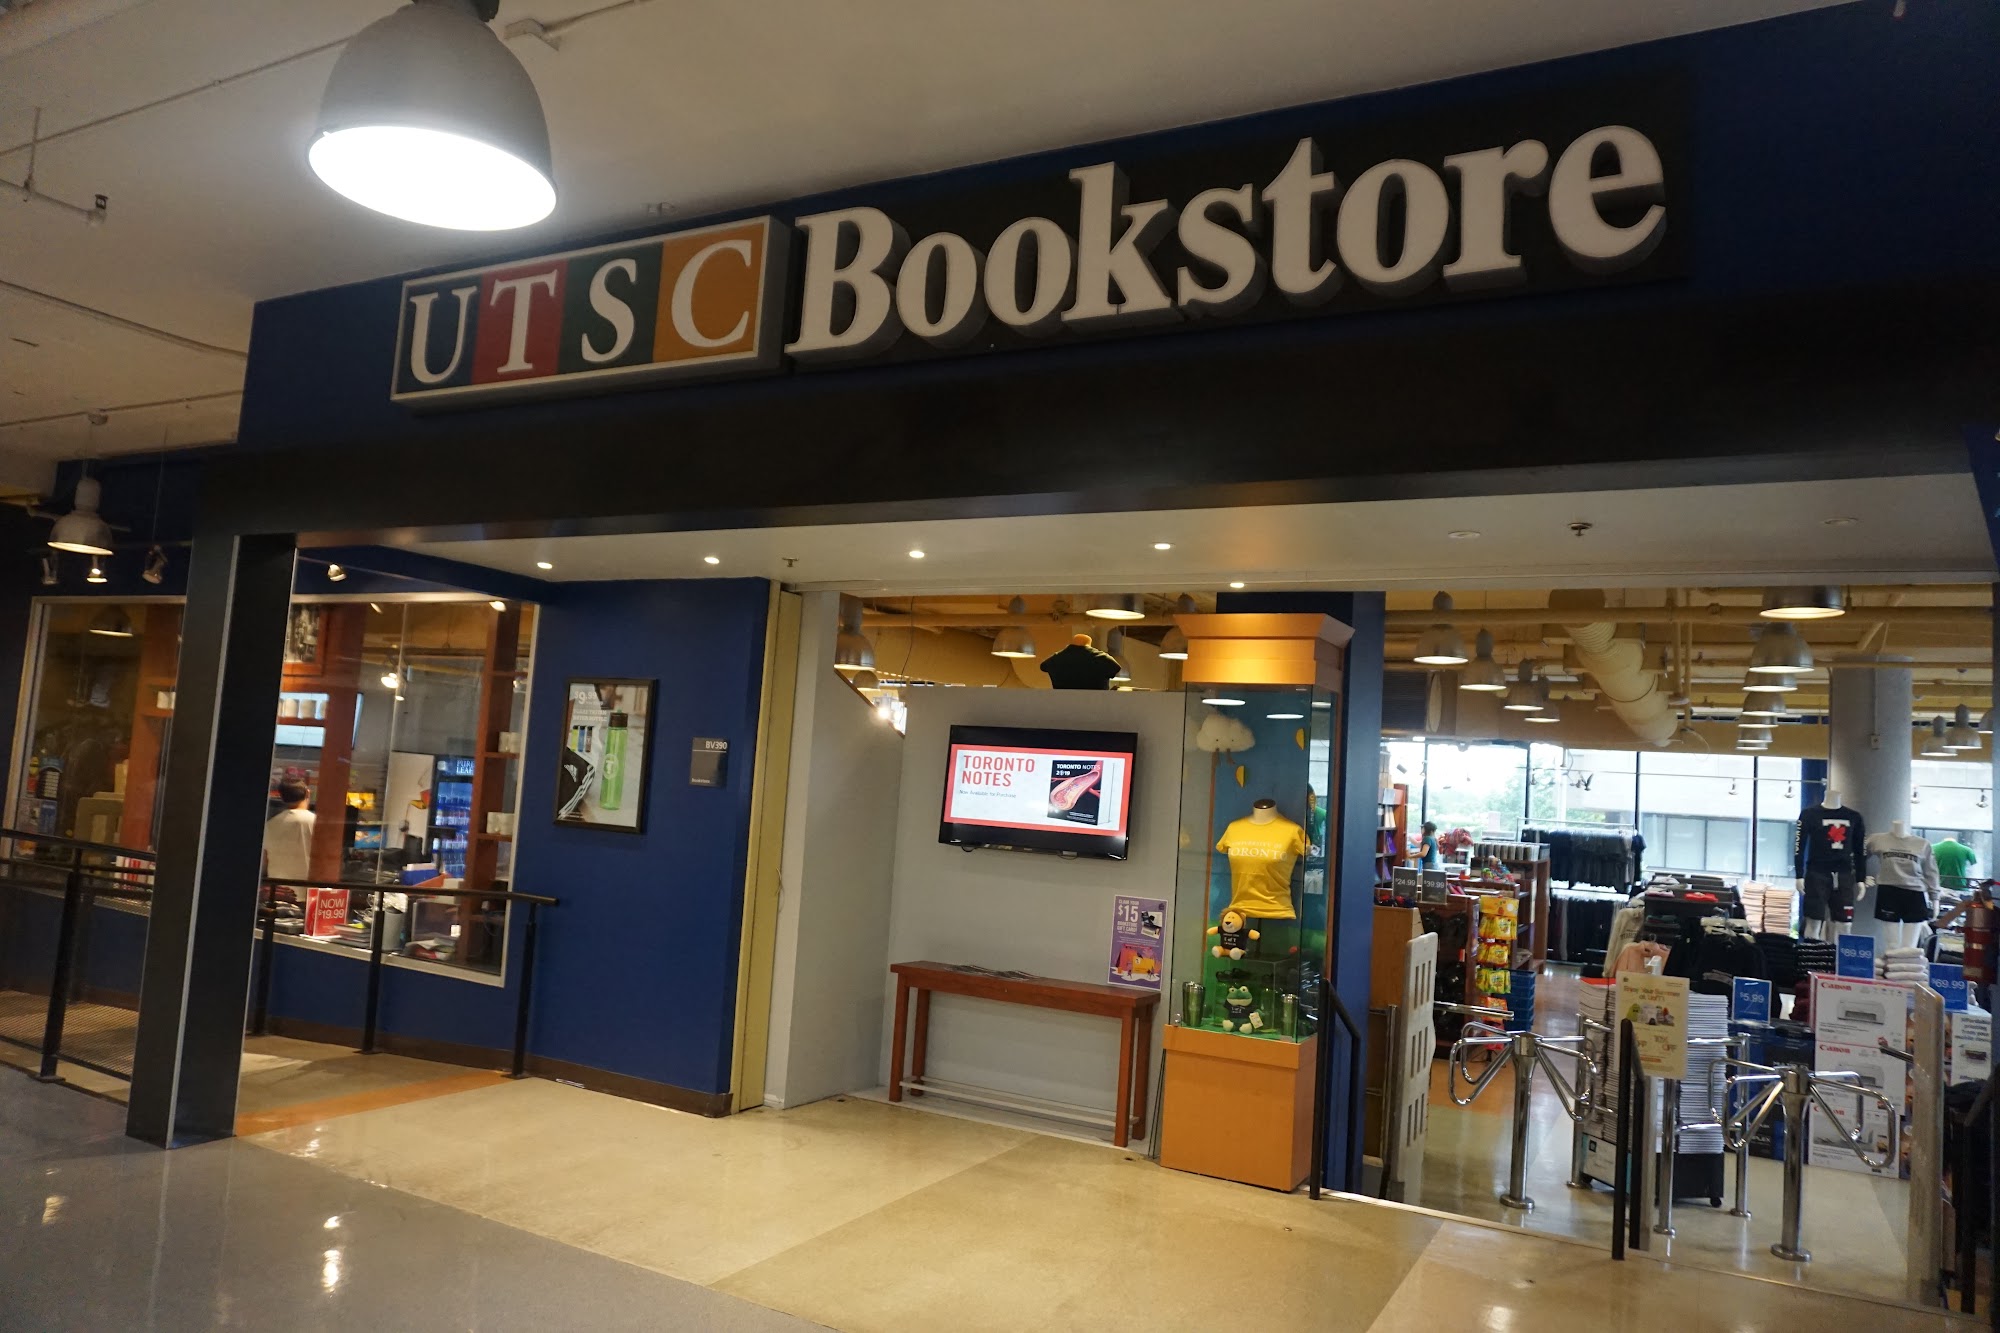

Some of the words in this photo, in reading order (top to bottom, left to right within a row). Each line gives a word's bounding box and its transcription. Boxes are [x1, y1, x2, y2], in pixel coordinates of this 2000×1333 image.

[408, 237, 755, 386] UTSC
[784, 124, 1666, 355] Bookstore
[705, 740, 728, 750] BV390
[963, 755, 1035, 773] TORONTO
[961, 771, 1012, 787] NOTES
[1395, 878, 1416, 886] $24.99
[320, 898, 345, 909] NOW
[317, 909, 345, 919] $19.99
[1117, 904, 1139, 923] $15
[1840, 947, 1873, 959] $89.99
[1820, 982, 1852, 991] Canon
[1931, 979, 1966, 990] $69.99
[1739, 991, 1765, 1004] $5.99
[1819, 1043, 1851, 1054] Canon
